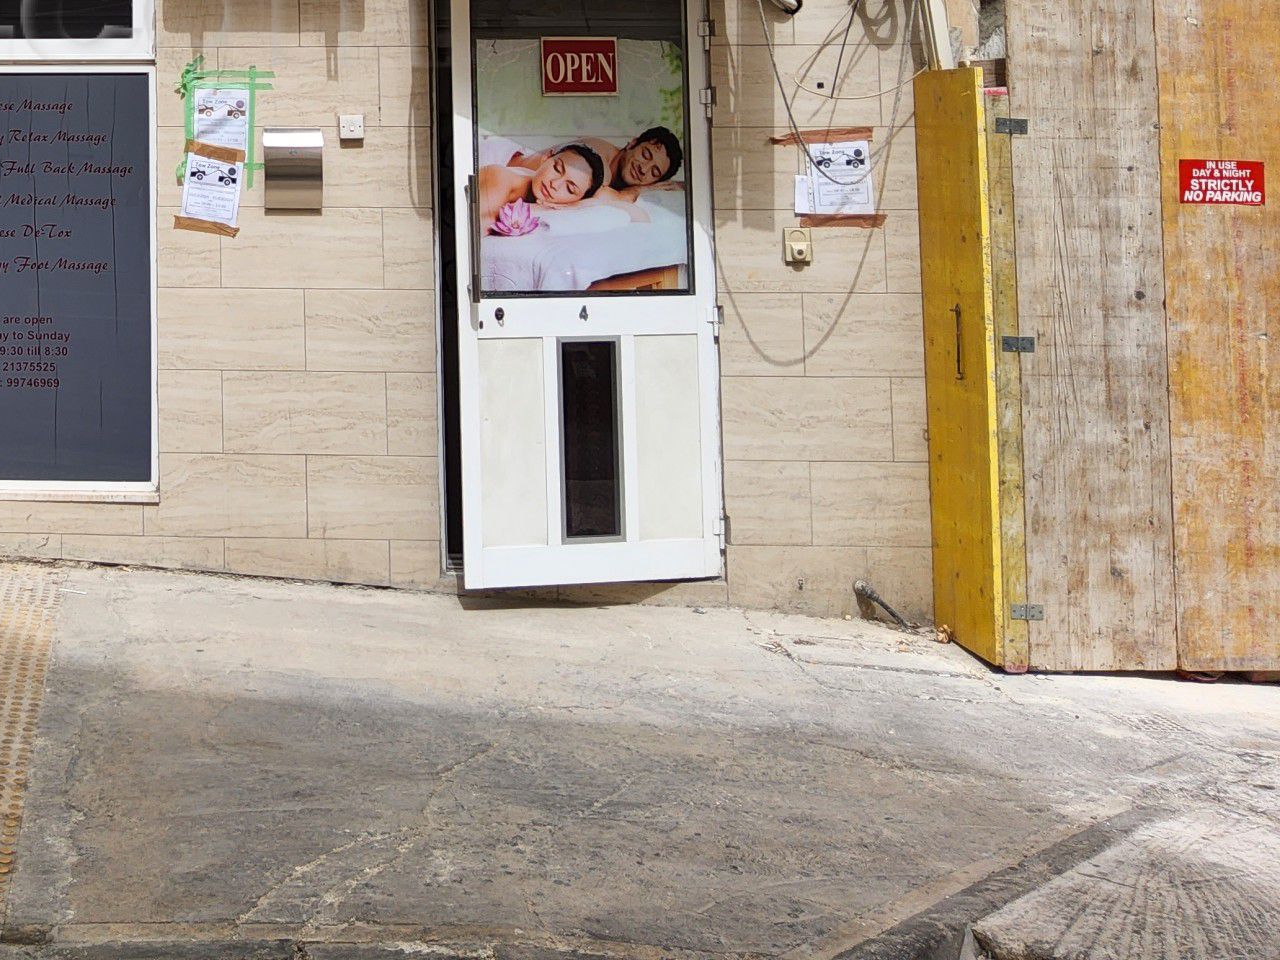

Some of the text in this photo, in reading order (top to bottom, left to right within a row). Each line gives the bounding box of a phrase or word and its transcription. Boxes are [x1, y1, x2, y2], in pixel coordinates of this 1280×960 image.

[546, 52, 614, 84] OPEN
[16, 99, 73, 114] Massage
[8, 130, 49, 143] Relax
[50, 131, 106, 145] Massage
[0, 161, 35, 177] Full
[42, 161, 74, 174] Back
[77, 162, 133, 177] Massage
[1206, 161, 1237, 169] IN USE
[1192, 169, 1251, 177] DAY & NIGHT
[1190, 179, 1254, 191] STRICTLY
[4, 194, 56, 208] Medical
[59, 194, 116, 210] Massage
[1184, 191, 1262, 202] NO PARKING
[14, 256, 49, 273] Foot
[51, 258, 108, 275] Massage
[24, 316, 53, 327] open
[13, 331, 24, 340] to
[27, 330, 70, 343] Sunday
[0, 346, 23, 356] 9:30
[27, 346, 41, 356] till
[44, 346, 68, 356] 8:30
[3, 362, 56, 372] 21375525
[6, 377, 60, 388] 99746969
